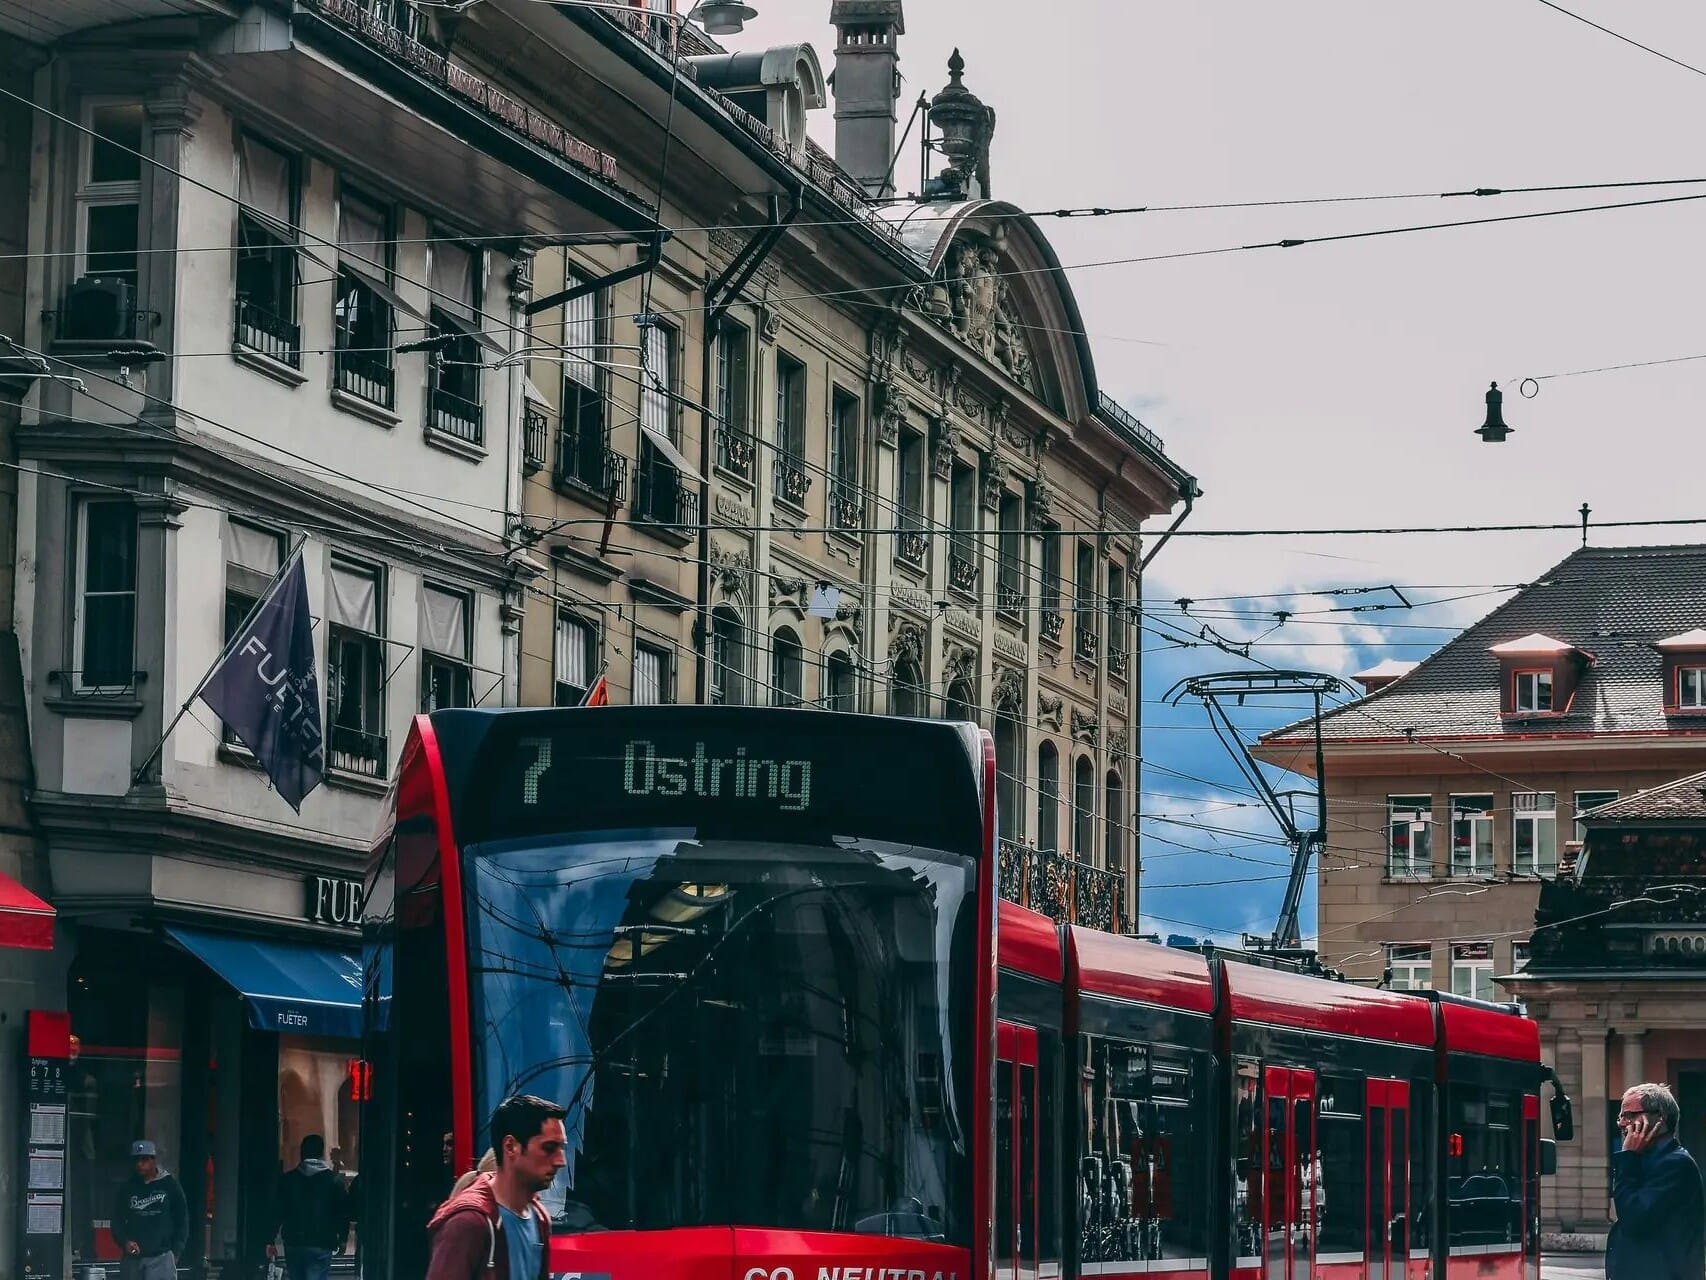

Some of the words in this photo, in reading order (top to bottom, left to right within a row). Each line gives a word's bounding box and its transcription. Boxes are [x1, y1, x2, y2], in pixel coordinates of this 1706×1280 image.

[519, 738, 552, 804] 7
[624, 740, 811, 810] Ostring
[315, 876, 363, 924] FUE
[277, 1013, 308, 1026] FUETER
[31, 1066, 36, 1077] 6
[43, 1066, 49, 1078] 7
[55, 1067, 61, 1078] 8
